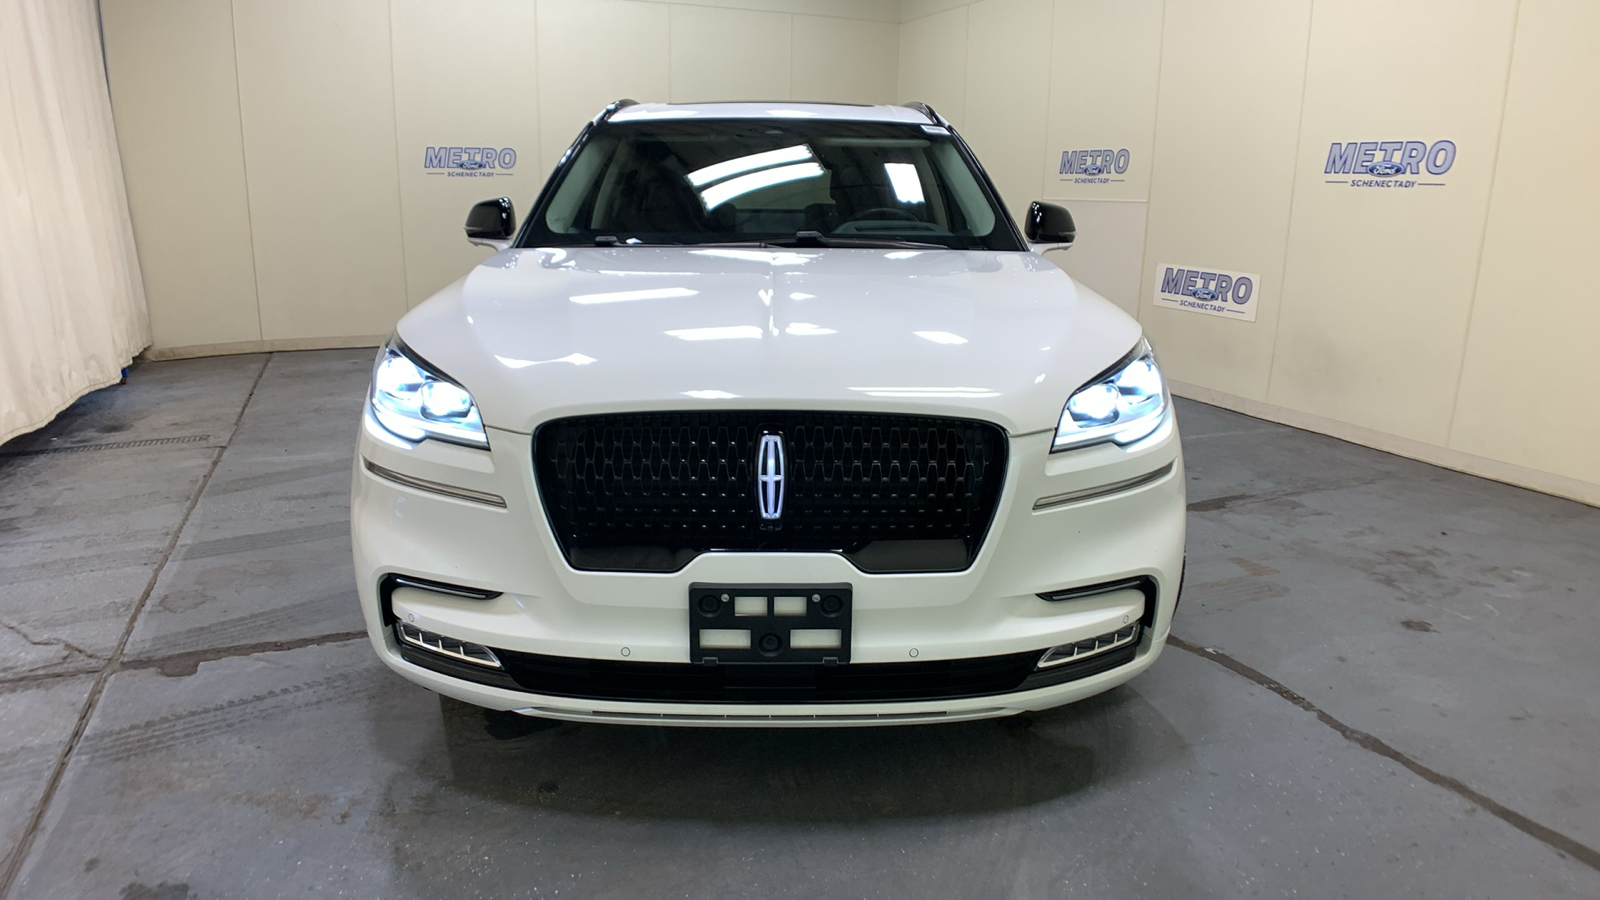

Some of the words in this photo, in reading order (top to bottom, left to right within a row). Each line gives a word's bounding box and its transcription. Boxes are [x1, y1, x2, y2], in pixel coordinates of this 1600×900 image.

[423, 147, 517, 169] METRO
[1059, 148, 1131, 174] METRO
[1324, 139, 1457, 175] METRO
[1350, 179, 1417, 188] SCHENECTADY
[1160, 267, 1253, 305] METRO
[1179, 299, 1226, 313] SCHENECTADY
